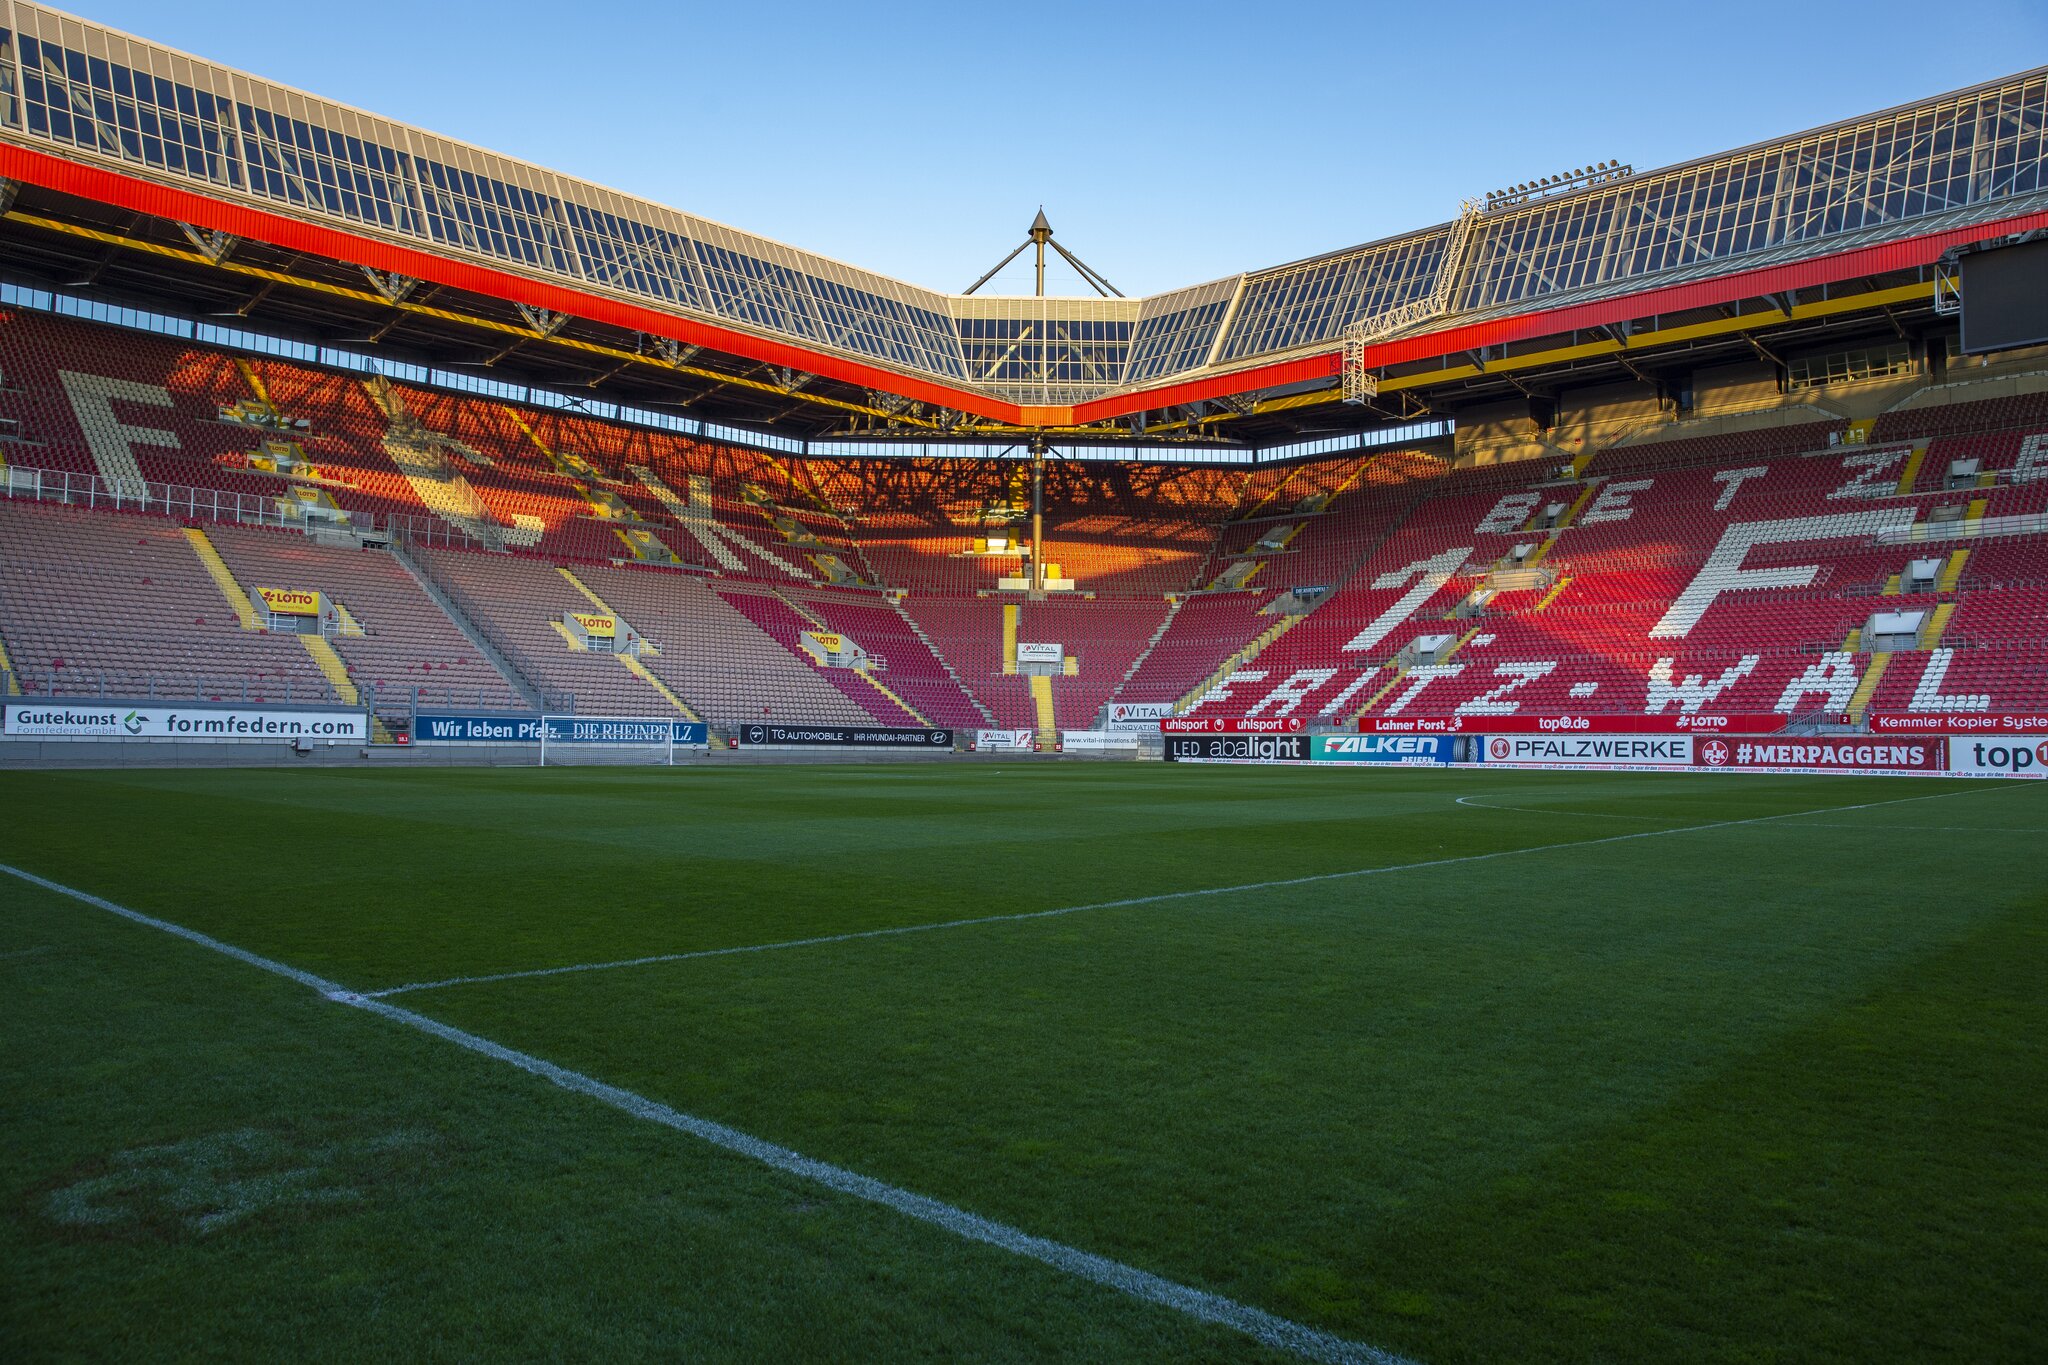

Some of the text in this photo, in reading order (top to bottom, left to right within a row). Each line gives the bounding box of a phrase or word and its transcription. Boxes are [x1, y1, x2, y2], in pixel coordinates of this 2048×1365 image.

[276, 593, 313, 605] LOTTO
[583, 618, 613, 629] LOTTO
[816, 636, 839, 645] LOTTO
[17, 710, 354, 735] Gutekunst formfedern.com
[1166, 718, 1283, 733] uhlsport uhlsport
[1376, 719, 1446, 731] Lahner Forst
[1539, 716, 1590, 732] top12.de
[1691, 716, 1728, 726] LOTTO
[1880, 716, 2048, 732] Kemmler Kopier Syste
[17, 725, 116, 735] Formfedern GmbH
[432, 721, 693, 741] Wir leben Pfalz. DIE RHEINPFALZ
[771, 729, 786, 739] TG
[787, 732, 843, 740] AUTOMOBILE
[866, 734, 926, 742] HYUNDAI-PARTNER
[1173, 736, 1300, 760] LED abalight
[1323, 736, 1439, 753] FALKEN
[1515, 741, 1686, 758] PFALZWERKE
[1736, 743, 1925, 765] #MERPAGGENS
